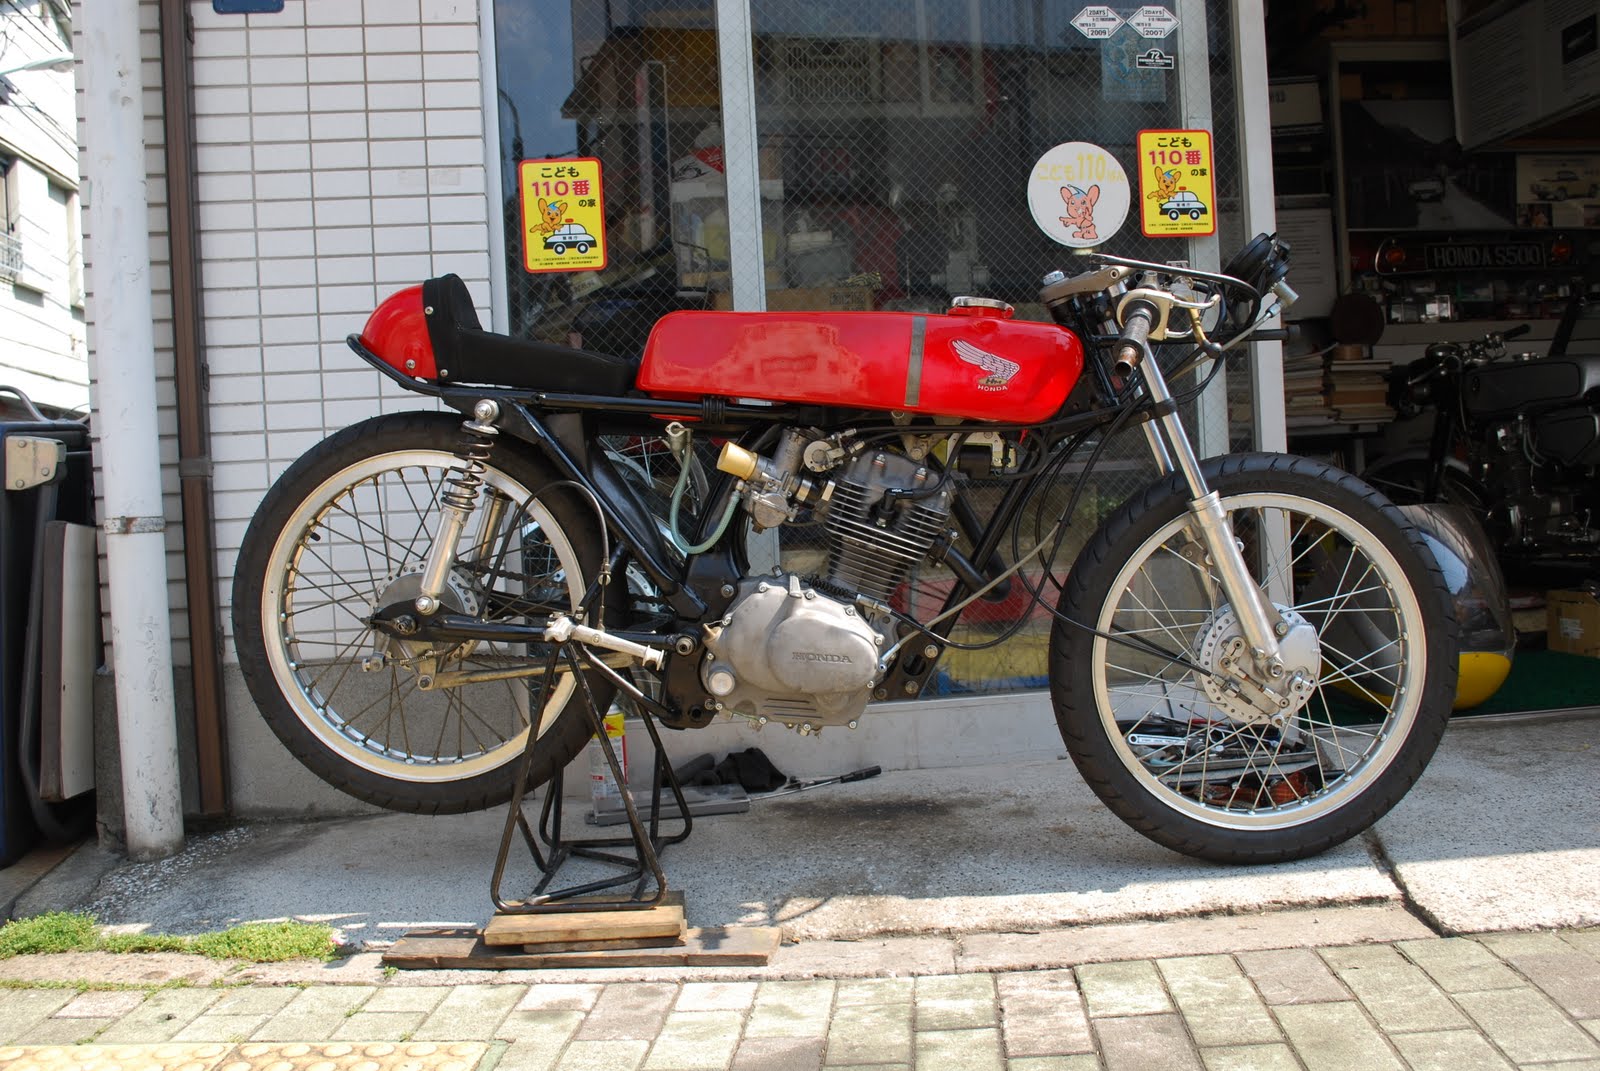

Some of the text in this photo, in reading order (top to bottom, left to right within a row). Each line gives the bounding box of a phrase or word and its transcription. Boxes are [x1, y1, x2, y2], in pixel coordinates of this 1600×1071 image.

[1150, 51, 1160, 59] 72
[1157, 136, 1192, 148] こども
[1148, 150, 1202, 166] 110番
[541, 166, 579, 178] こども
[1190, 168, 1208, 177] の家
[532, 180, 589, 196] 110番
[578, 198, 597, 208] の家
[1433, 245, 1540, 268] HONDA S500
[977, 384, 1008, 392] HONDA
[791, 651, 853, 664] HONDA
